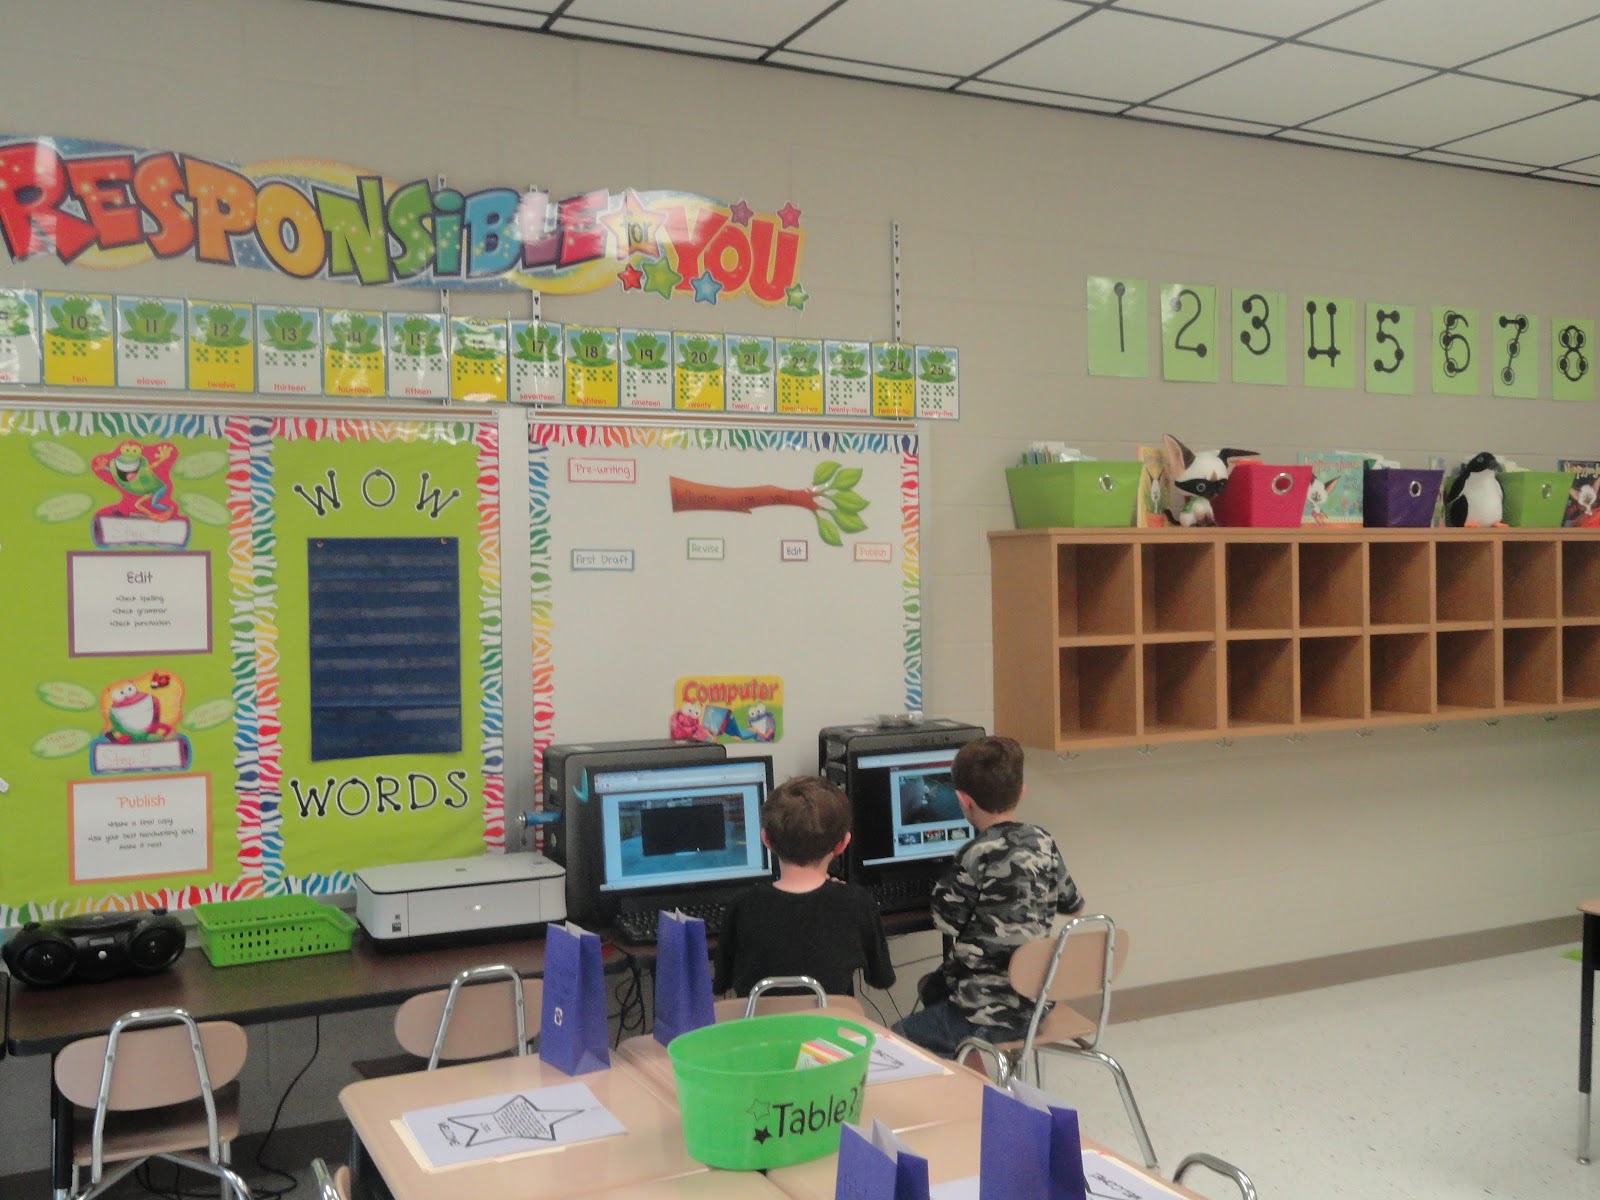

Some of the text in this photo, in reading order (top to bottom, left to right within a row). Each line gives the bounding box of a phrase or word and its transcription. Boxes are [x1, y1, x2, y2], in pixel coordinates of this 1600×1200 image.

[656, 205, 800, 300] YOU
[70, 315, 89, 330] 10
[1113, 281, 1126, 353] 1
[1170, 289, 1207, 359] 2
[145, 318, 158, 334] 11
[213, 323, 230, 338] 12
[1240, 294, 1272, 356] 3
[281, 327, 298, 342] 13
[1306, 300, 1342, 368] 4
[1373, 309, 1406, 374] 5
[532, 340, 545, 353] 17
[1439, 310, 1472, 377] 6
[1498, 313, 1530, 386] 7
[585, 346, 599, 360] 18
[639, 347, 654, 362] 19
[691, 351, 708, 365] 20
[743, 353, 756, 366] 21
[1556, 325, 1590, 382] 8
[889, 360, 905, 373] 24
[930, 363, 945, 377] 25
[72, 375, 88, 385] ten
[136, 377, 167, 386] eleven
[207, 380, 236, 389] twelve
[273, 383, 307, 393] thirteen
[519, 393, 556, 401] seventeen
[576, 398, 608, 407] eighteen
[631, 398, 661, 407] nineteen
[731, 402, 770, 412] twen-one
[576, 464, 631, 480] Pre-writing
[691, 543, 720, 554] Revise
[786, 546, 803, 557] Edit
[576, 554, 629, 565] First Draft
[126, 570, 154, 585] Edit
[682, 678, 779, 705] Computer
[115, 793, 166, 809] Publish
[289, 770, 469, 818] WORDS
[772, 1093, 848, 1138] Table
